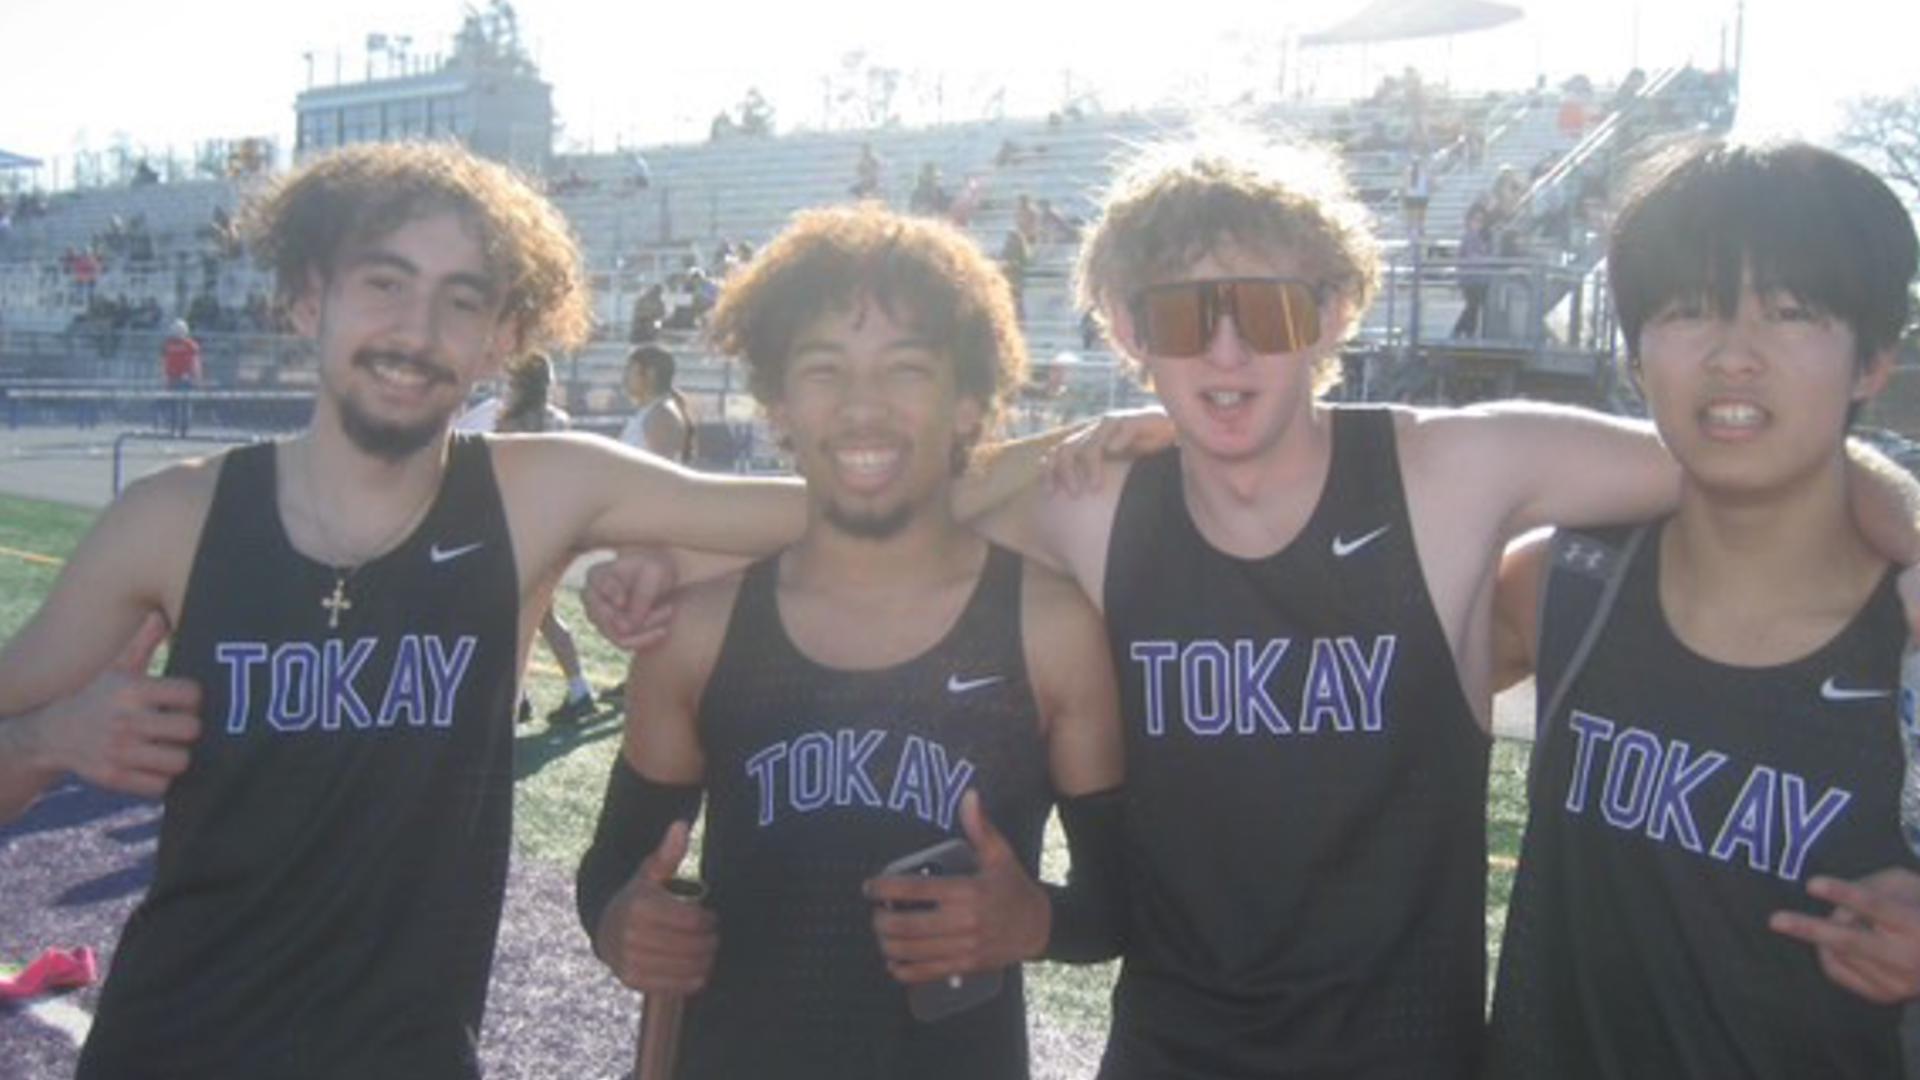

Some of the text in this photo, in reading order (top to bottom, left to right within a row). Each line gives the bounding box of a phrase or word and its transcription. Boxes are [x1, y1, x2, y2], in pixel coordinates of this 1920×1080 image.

[216, 634, 478, 734] TOKAY
[1131, 634, 1397, 736] TOKAY
[745, 727, 975, 830] TOKAY
[1565, 709, 1851, 882] TOKAY
